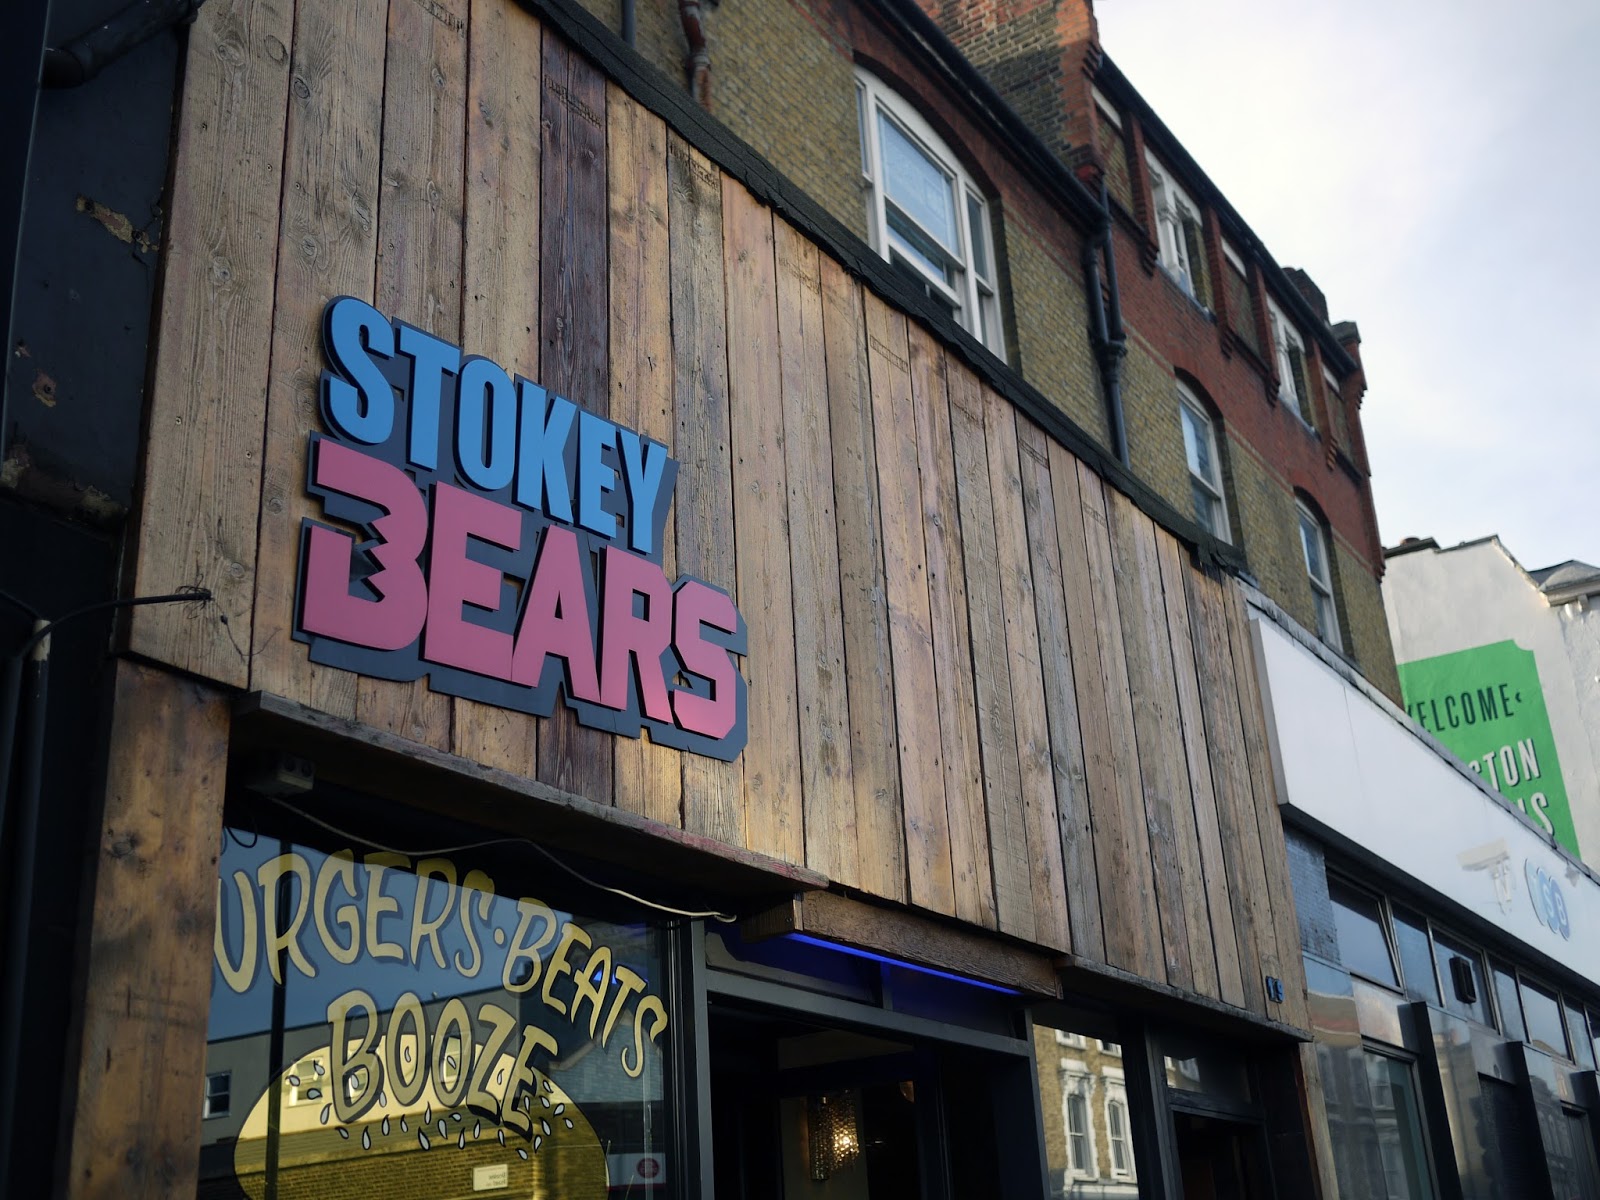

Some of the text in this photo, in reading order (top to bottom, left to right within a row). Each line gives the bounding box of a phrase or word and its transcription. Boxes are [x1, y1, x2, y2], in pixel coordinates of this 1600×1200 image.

[326, 297, 668, 554] STOKEY
[302, 438, 737, 740] BEARS
[501, 896, 668, 1079] BEATS
[1528, 867, 1568, 931] TSB
[326, 989, 558, 1142] BOOZE
